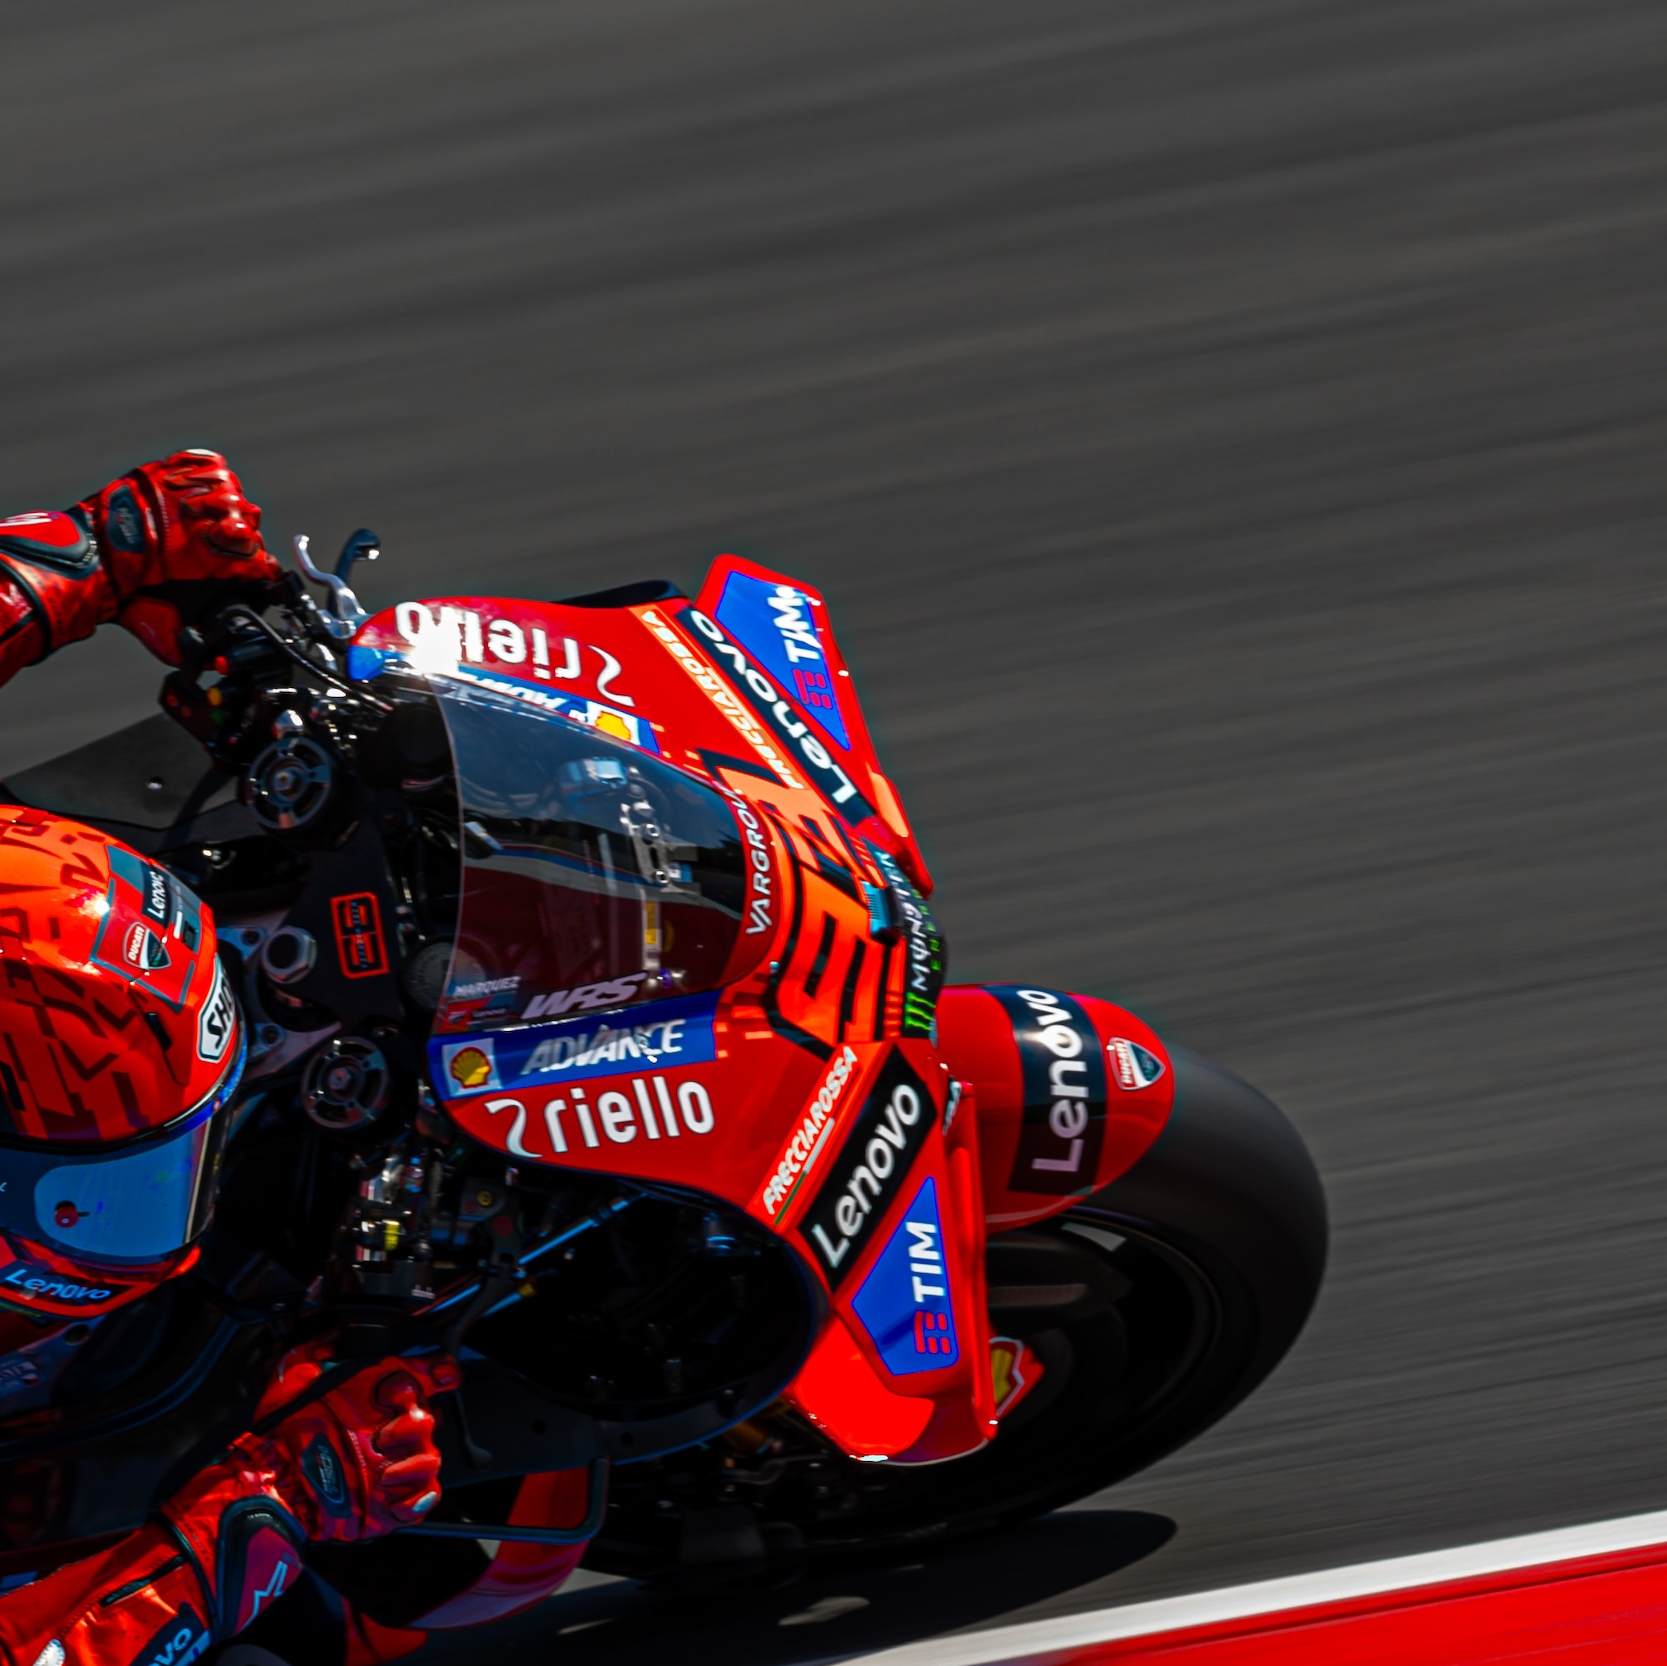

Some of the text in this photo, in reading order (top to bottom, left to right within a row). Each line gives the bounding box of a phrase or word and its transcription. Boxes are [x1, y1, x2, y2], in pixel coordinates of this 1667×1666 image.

[767, 596, 821, 663] TIM
[642, 611, 804, 789] FRECCIAROSSA
[690, 610, 857, 803] Lenovo
[147, 870, 165, 919] Lenov
[874, 851, 931, 991] MONSTER
[904, 876, 941, 971] ENERG
[128, 925, 145, 961] DUCATI
[521, 971, 648, 1019] WRS
[519, 1019, 686, 1075] ADVANCE
[1016, 989, 1089, 1172] Lenovo
[543, 1076, 715, 1153] riello
[763, 1046, 858, 1215] FRECCIAROSSA
[811, 1084, 922, 1268] Lenovo
[5, 1268, 111, 1300] Lenovo
[905, 1221, 946, 1303] TIM
